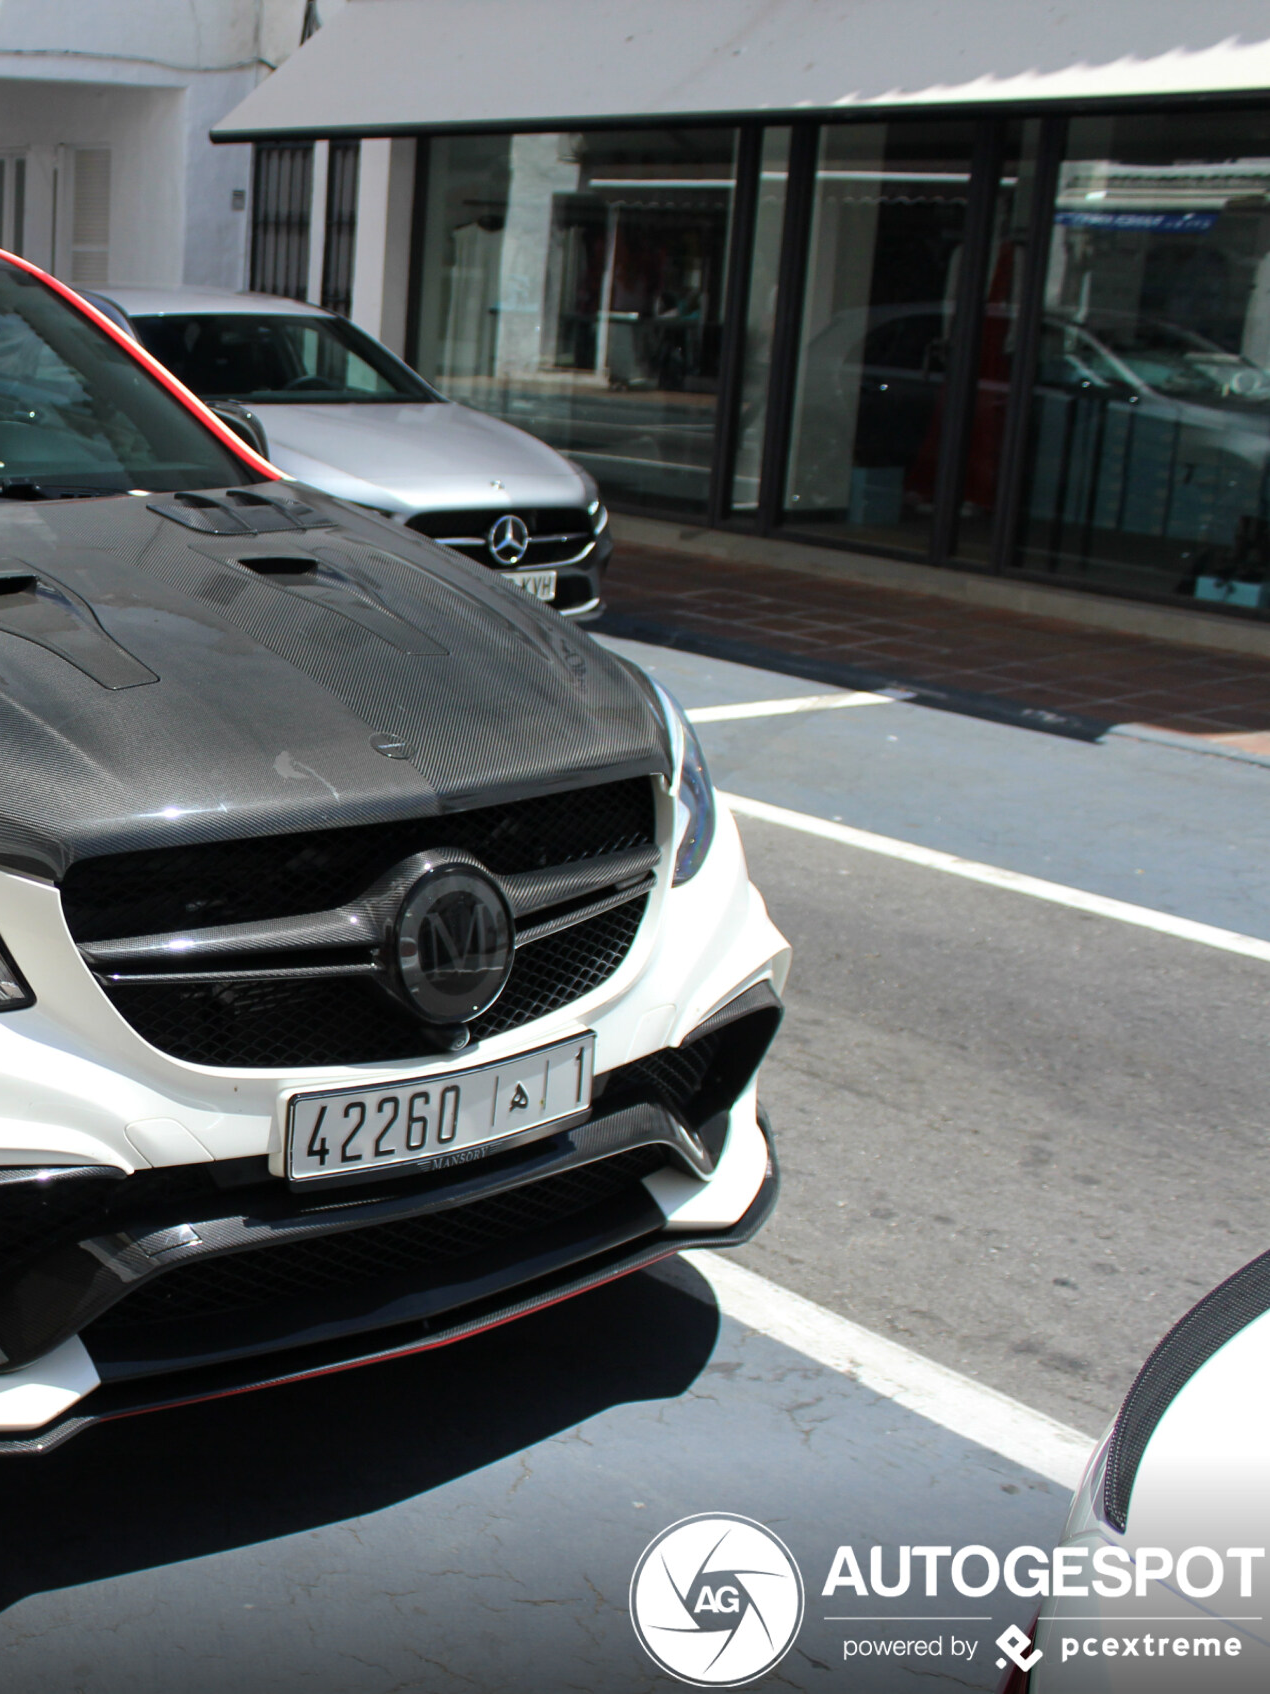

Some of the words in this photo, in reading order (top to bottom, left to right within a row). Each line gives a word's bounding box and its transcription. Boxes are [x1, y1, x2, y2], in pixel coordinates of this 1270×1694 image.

[575, 1046, 585, 1103] 1
[307, 1085, 461, 1167] 42260
[431, 1145, 490, 1171] MANSORY
